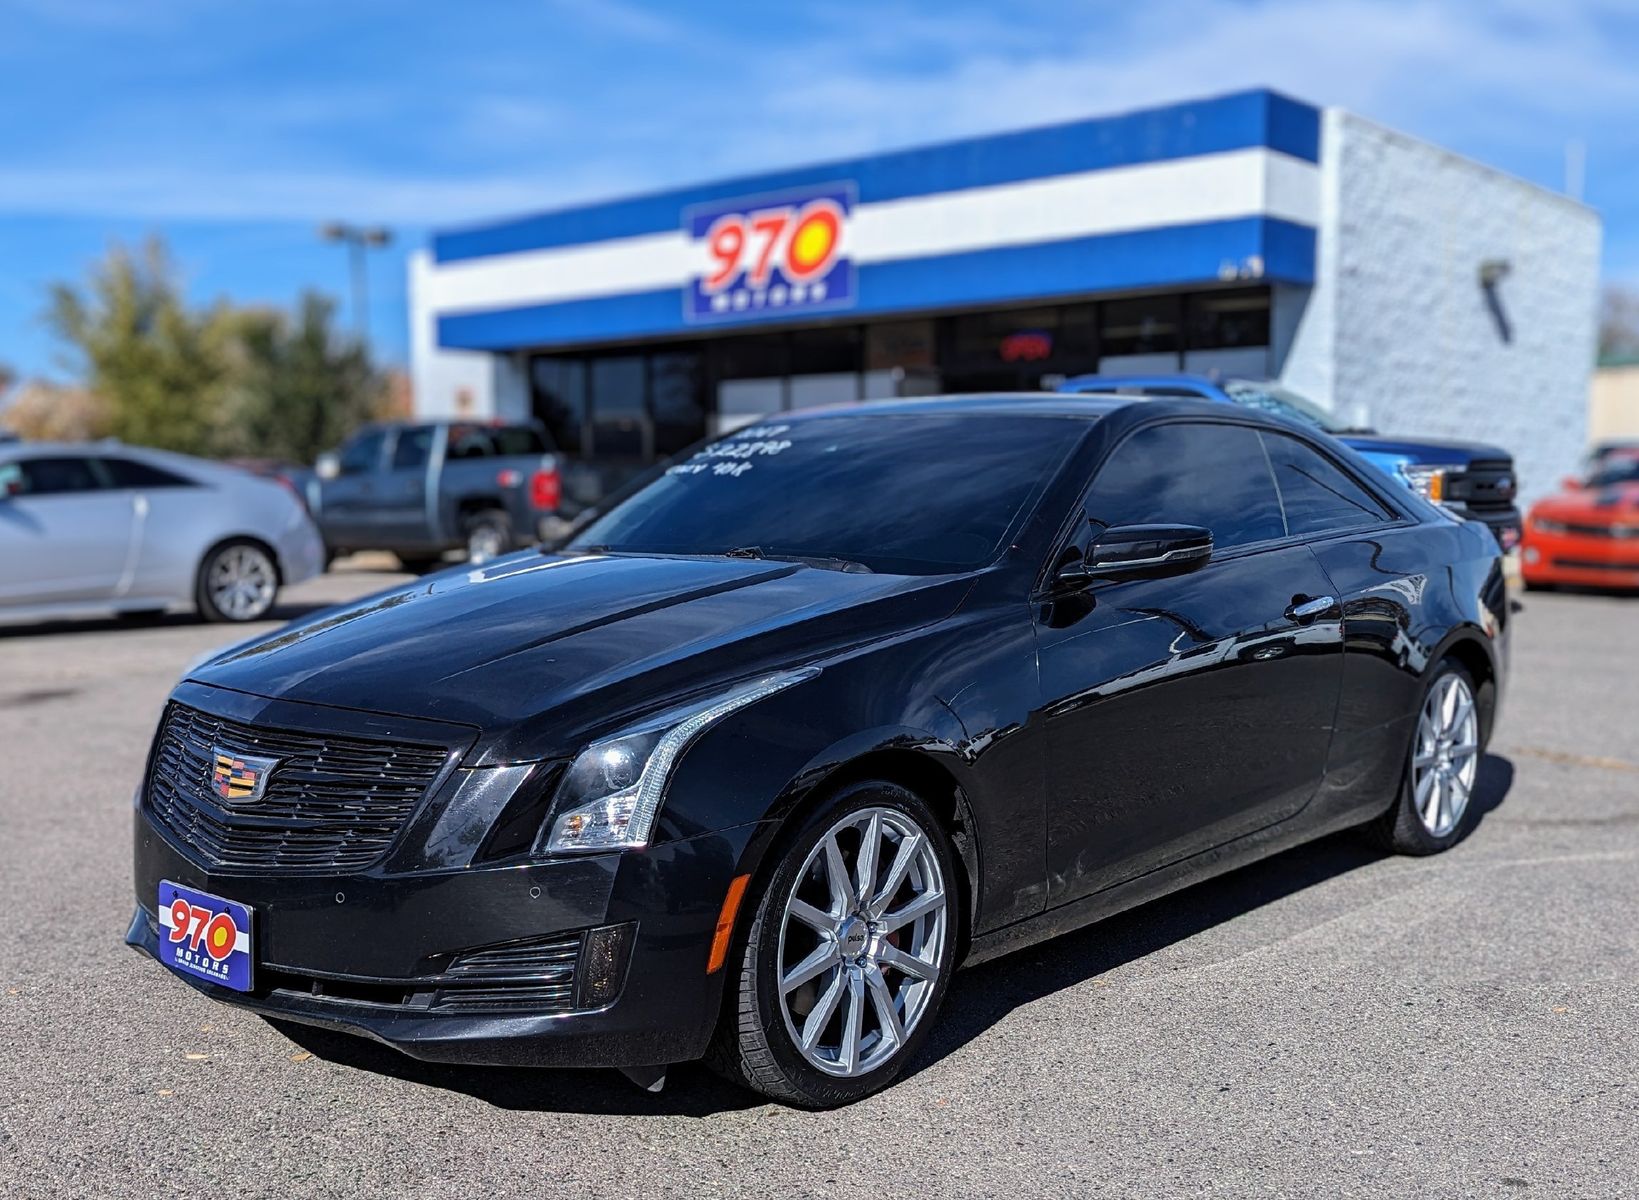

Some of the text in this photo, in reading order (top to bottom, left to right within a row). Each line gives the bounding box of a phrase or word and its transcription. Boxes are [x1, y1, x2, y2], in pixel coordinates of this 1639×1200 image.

[702, 201, 843, 295] 970
[169, 899, 237, 961] 970
[176, 947, 229, 975] MOTORS
